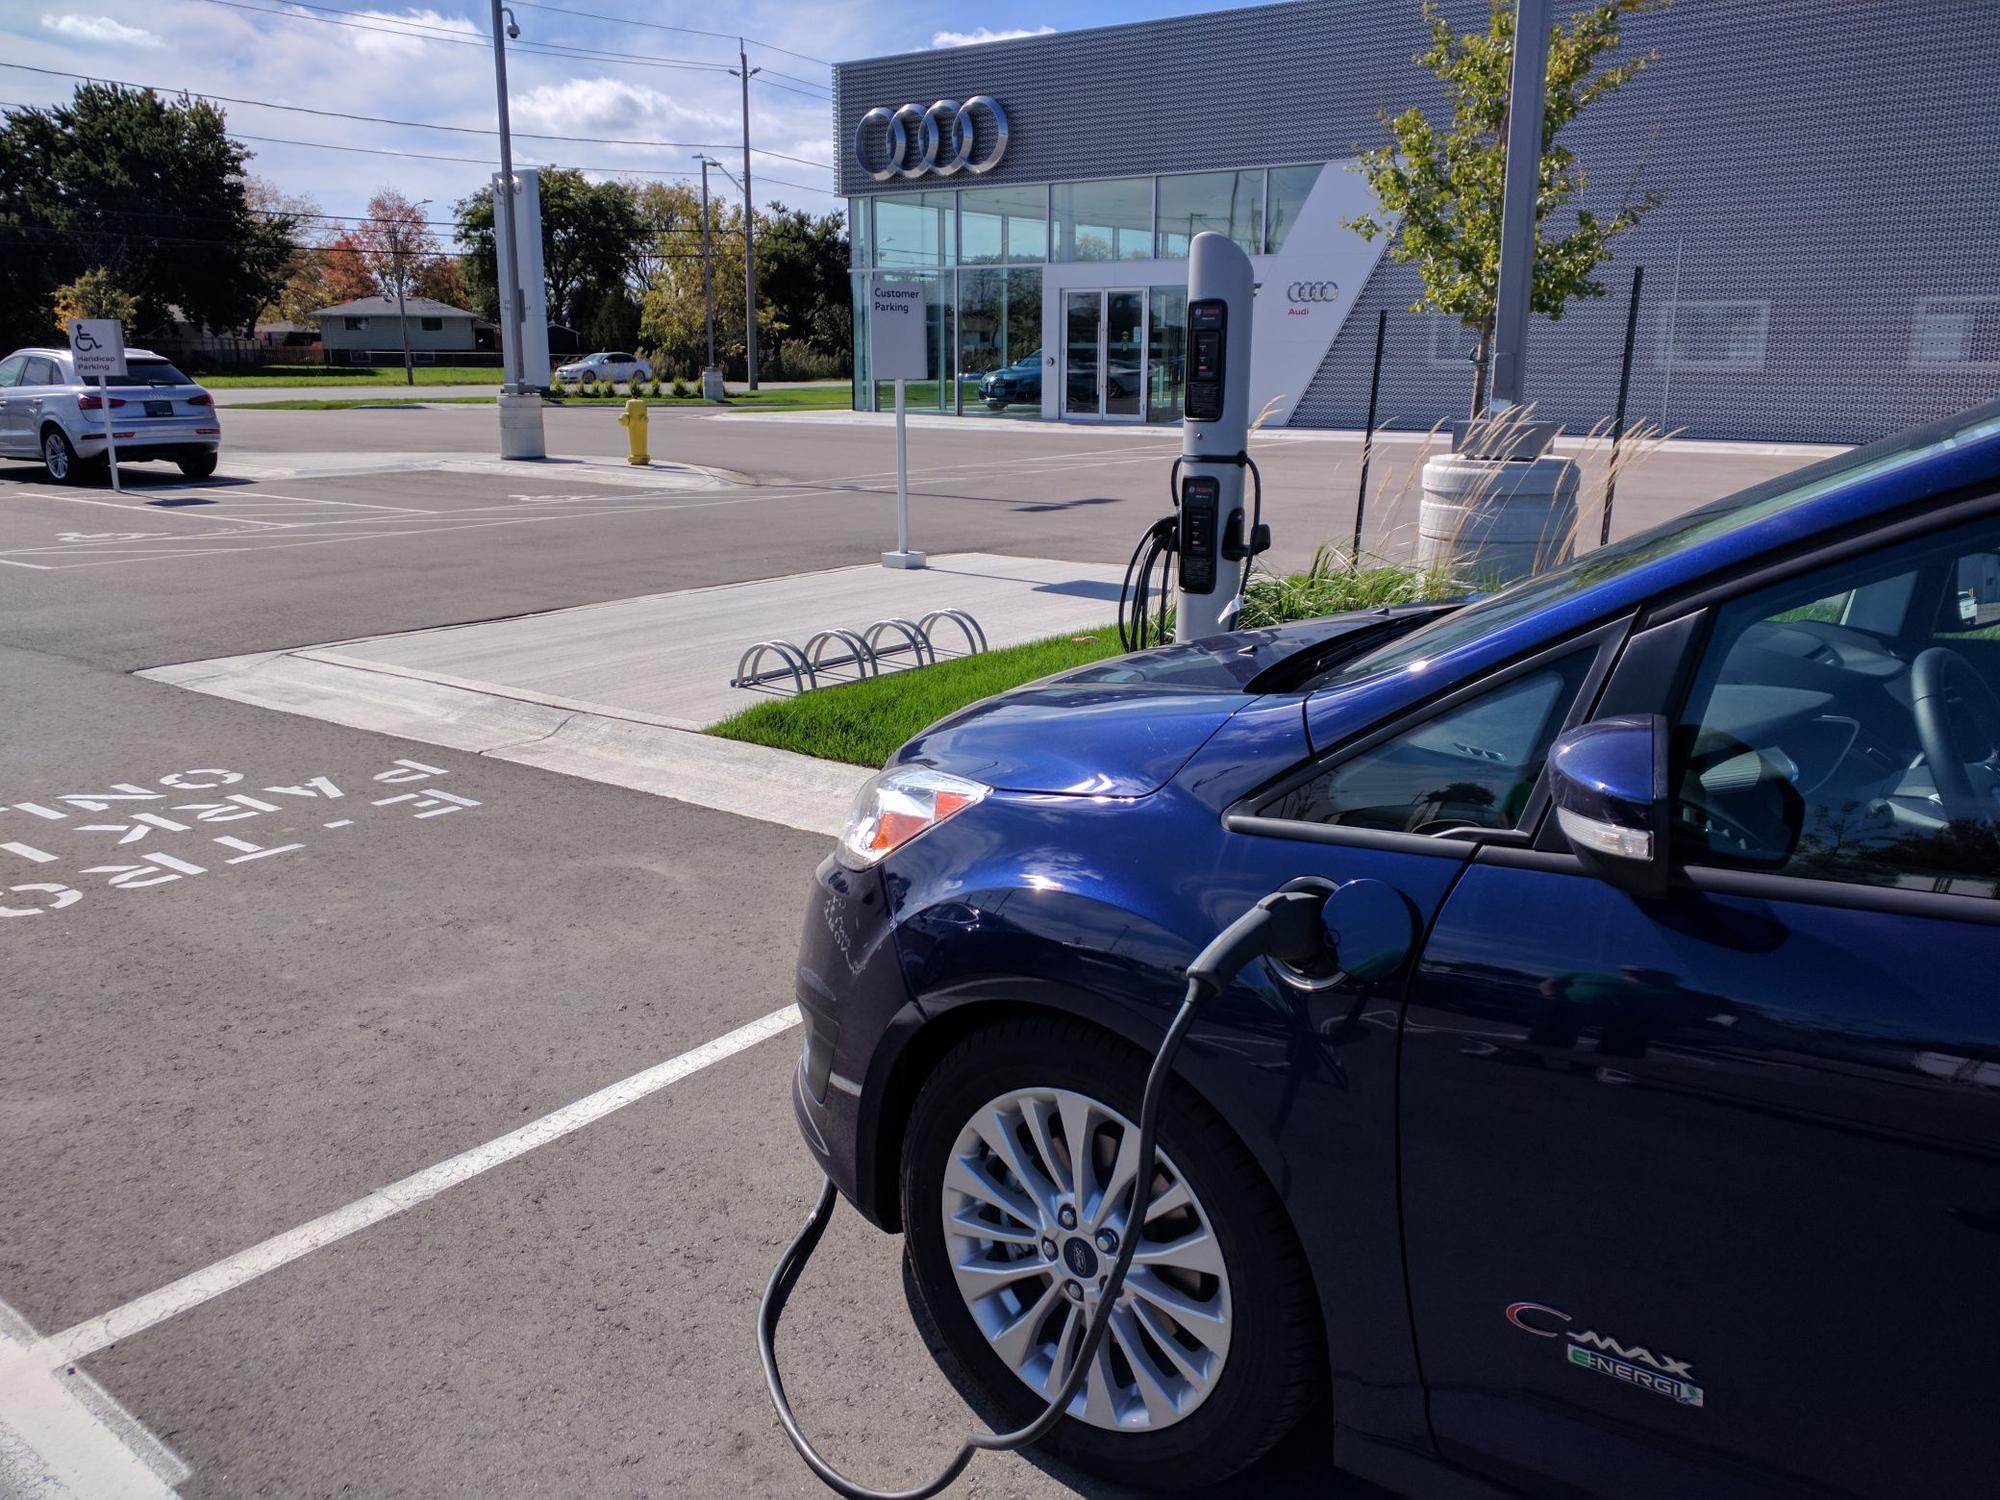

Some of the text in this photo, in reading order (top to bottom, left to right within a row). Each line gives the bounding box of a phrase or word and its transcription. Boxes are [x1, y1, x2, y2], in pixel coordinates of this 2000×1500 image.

[874, 287, 920, 299] Customer
[874, 302, 909, 314] Parking
[1288, 308, 1309, 316] Audi
[1505, 1301, 1696, 1381] C-MAX
[1571, 1348, 1681, 1398] ENERGI
